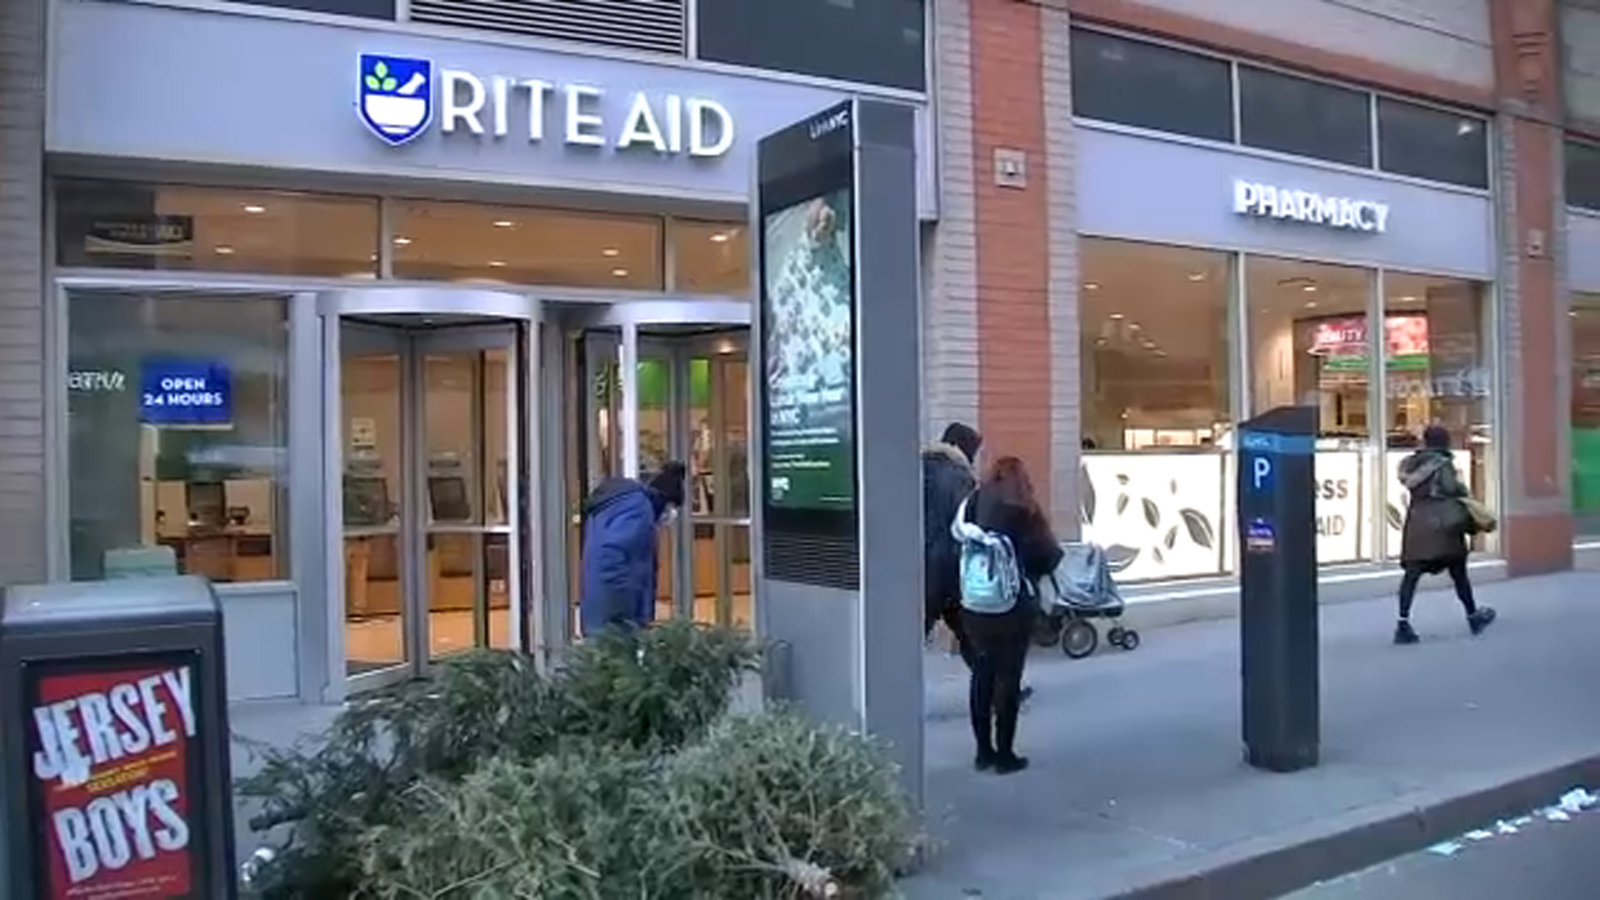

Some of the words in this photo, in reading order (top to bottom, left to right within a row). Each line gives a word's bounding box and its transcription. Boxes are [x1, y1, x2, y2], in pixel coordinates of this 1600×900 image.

[440, 69, 605, 146] RITE
[617, 91, 734, 157] AID
[1234, 179, 1389, 232] PHARMACY
[143, 393, 164, 406] 24
[167, 392, 224, 407] HOURS
[161, 377, 206, 391] OPEN
[1254, 457, 1271, 489] P
[33, 666, 197, 786] JERSEY
[53, 778, 190, 883] BOYS
